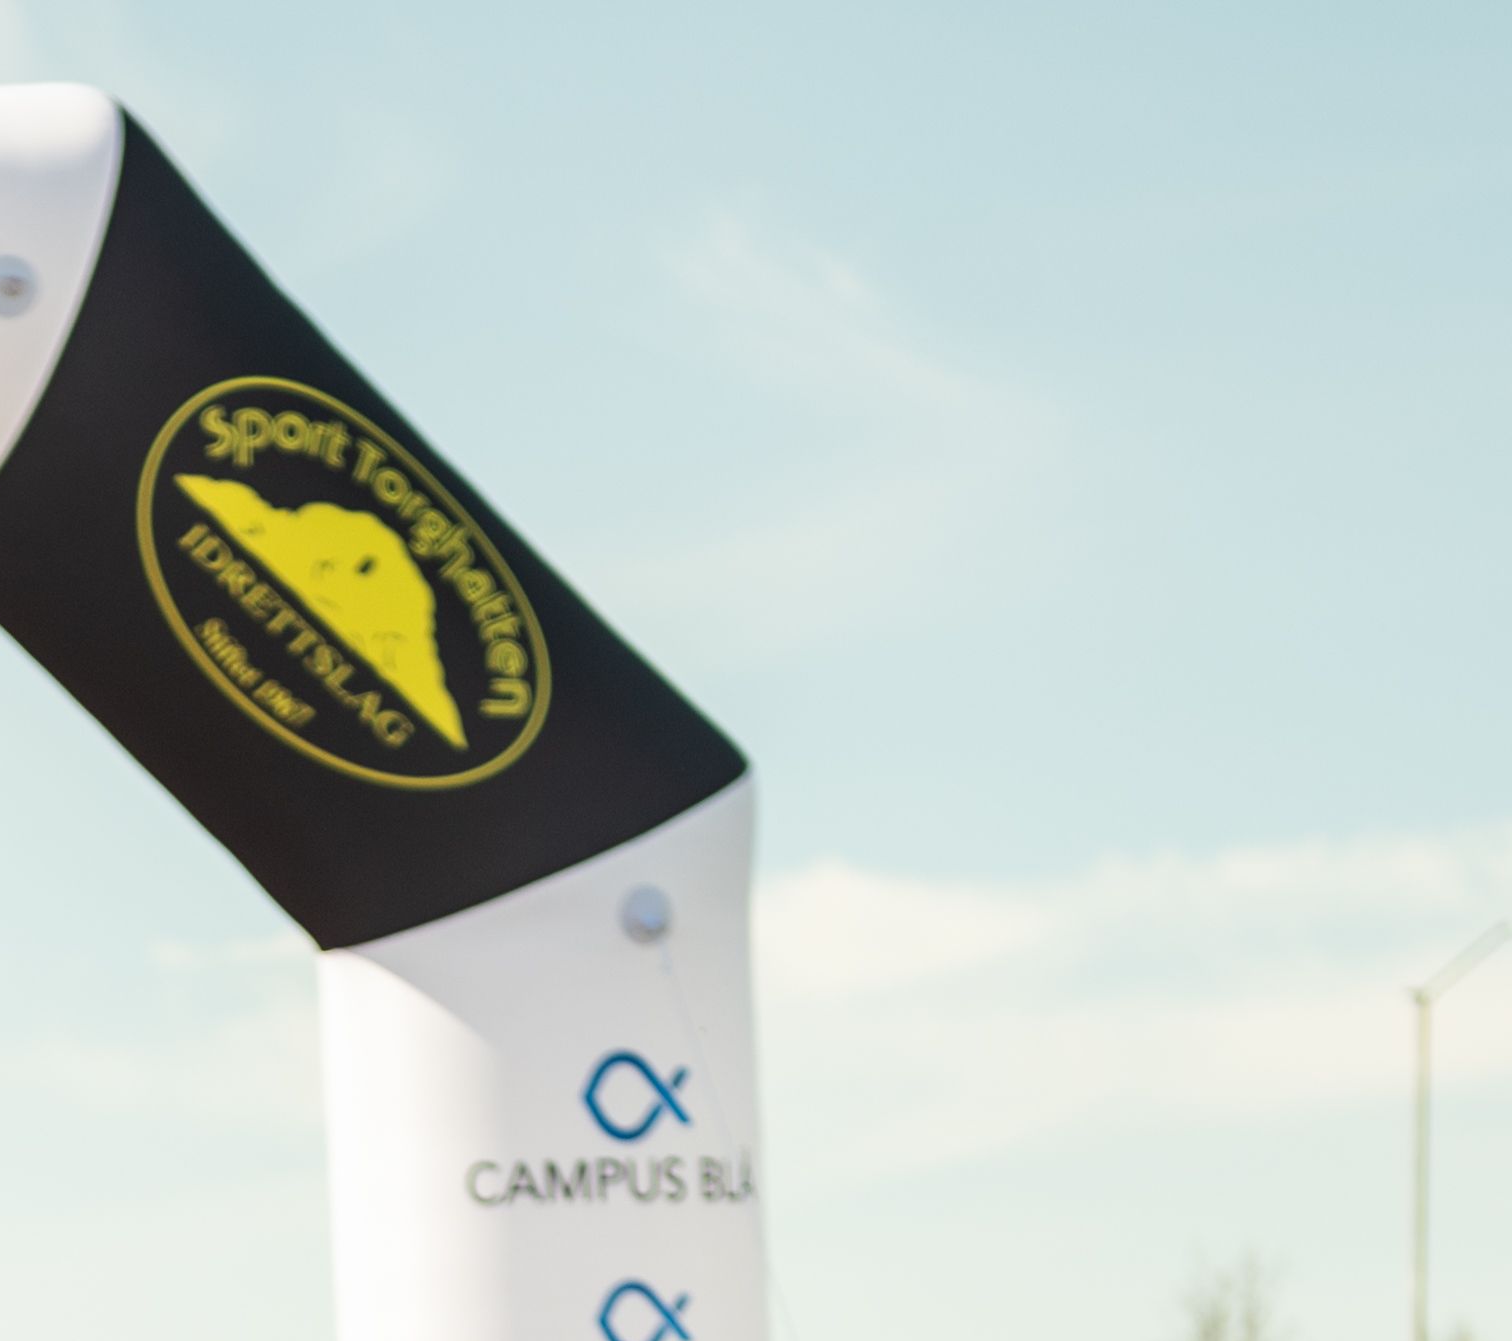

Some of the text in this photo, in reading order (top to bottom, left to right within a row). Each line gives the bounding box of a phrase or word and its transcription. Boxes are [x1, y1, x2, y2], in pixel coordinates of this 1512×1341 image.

[178, 523, 414, 750] IDRETTSLAG
[200, 404, 533, 717] Sport Torghatten
[466, 1155, 687, 1205] CAMPUS
